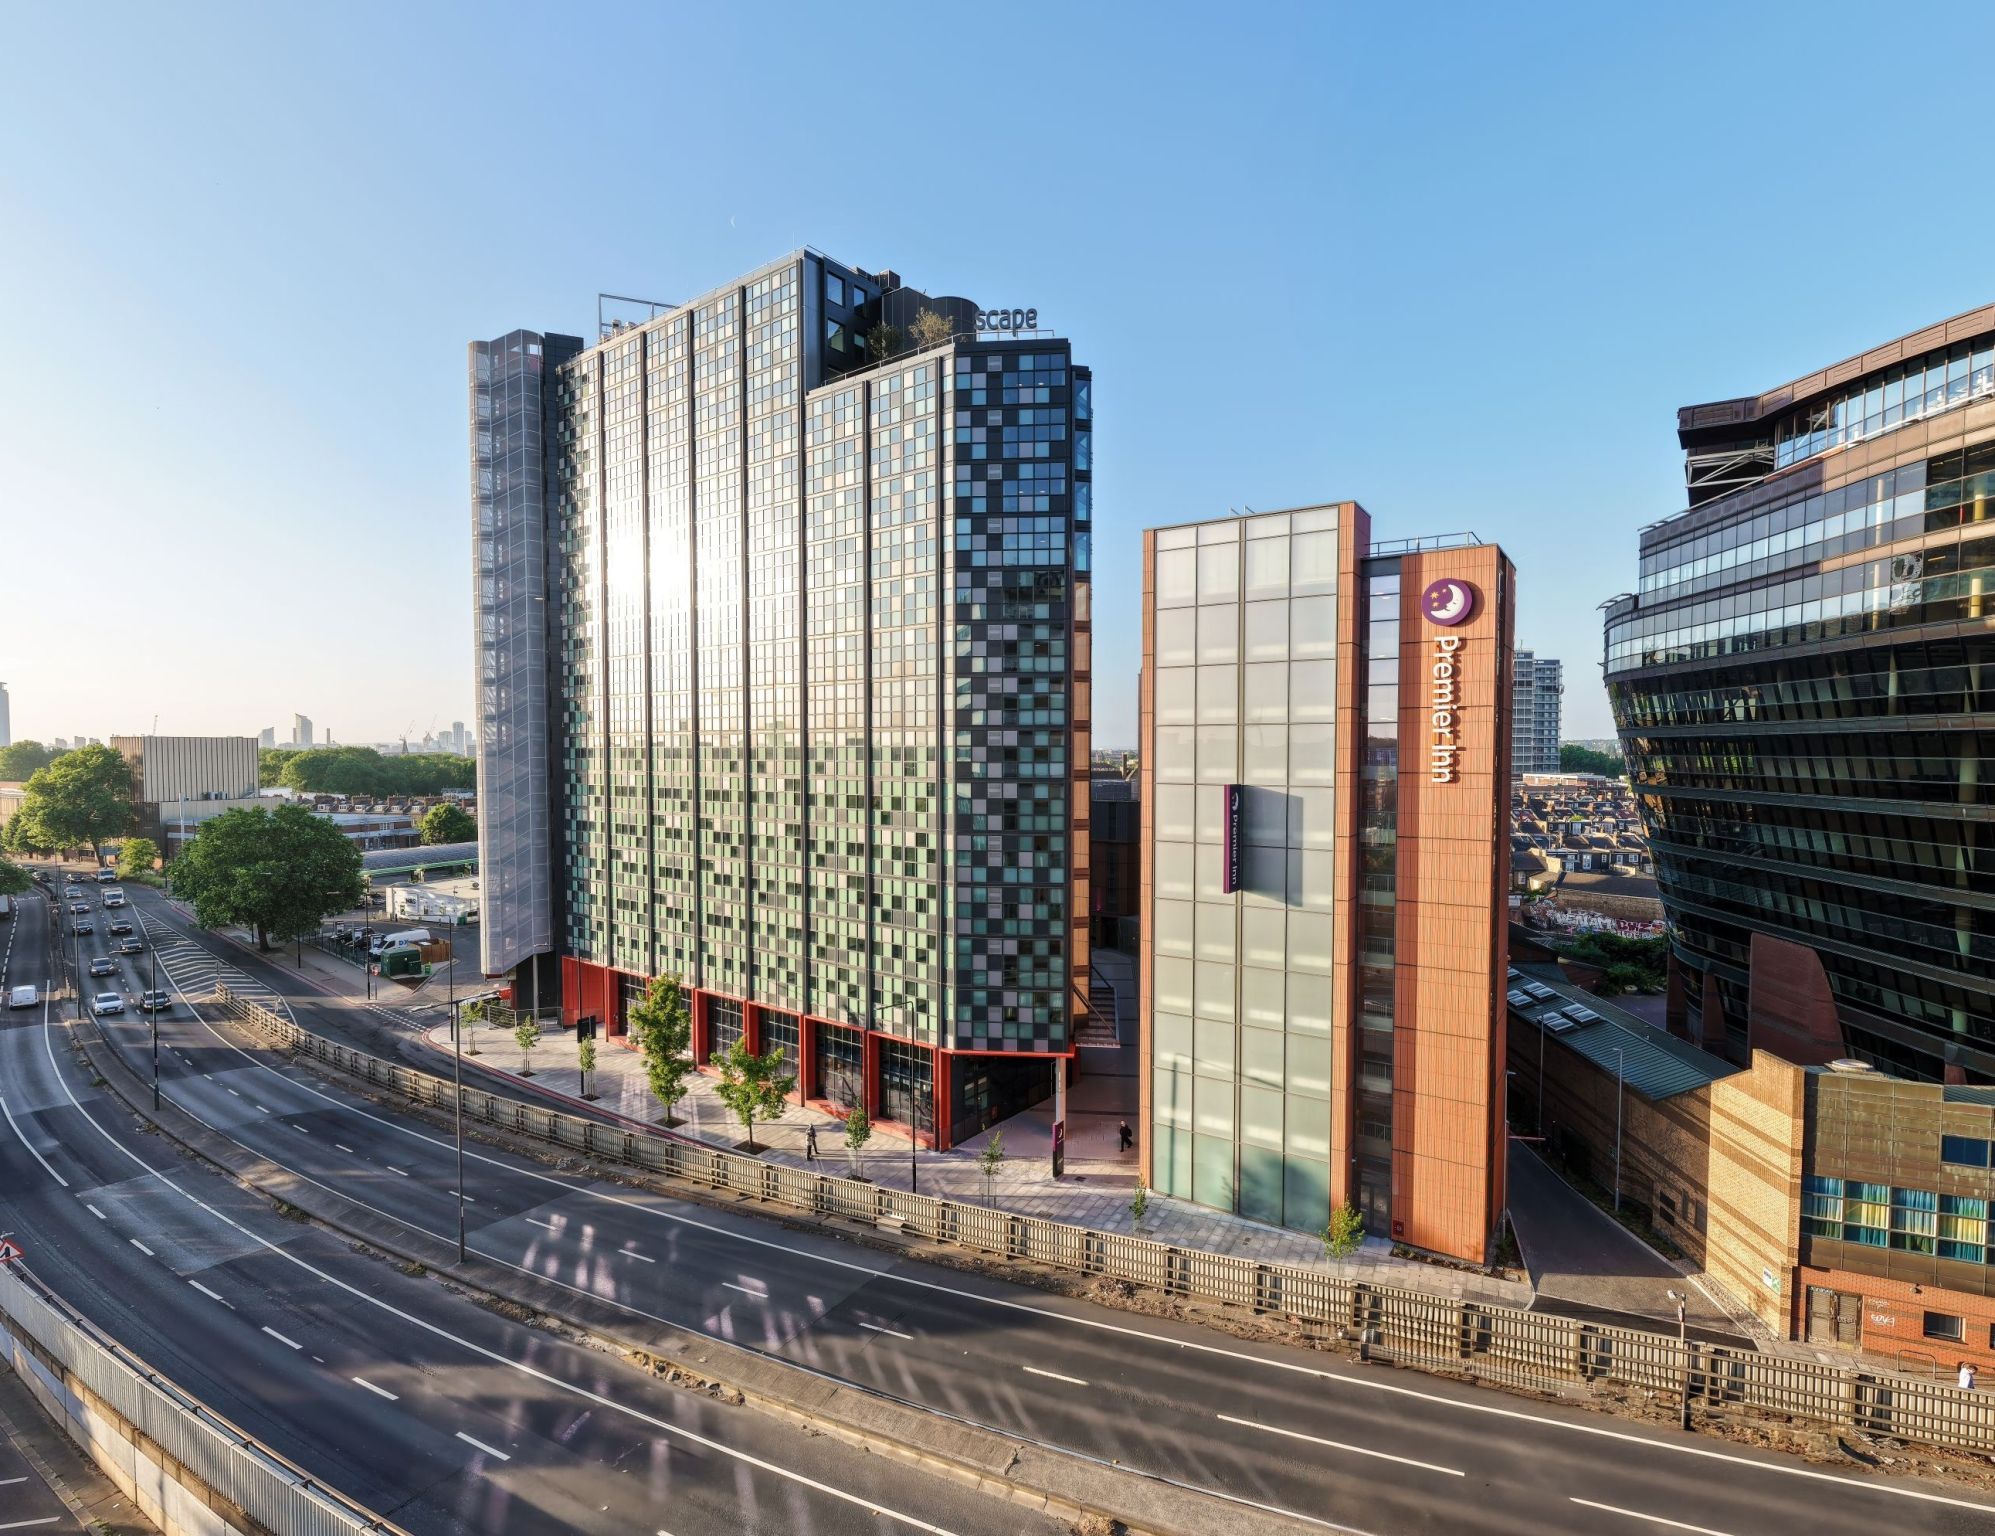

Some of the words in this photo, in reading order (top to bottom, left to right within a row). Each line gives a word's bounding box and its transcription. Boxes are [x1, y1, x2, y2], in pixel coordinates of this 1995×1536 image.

[974, 308, 1037, 337] scape
[1431, 635, 1459, 738] Premier
[1431, 745, 1457, 783] Inn
